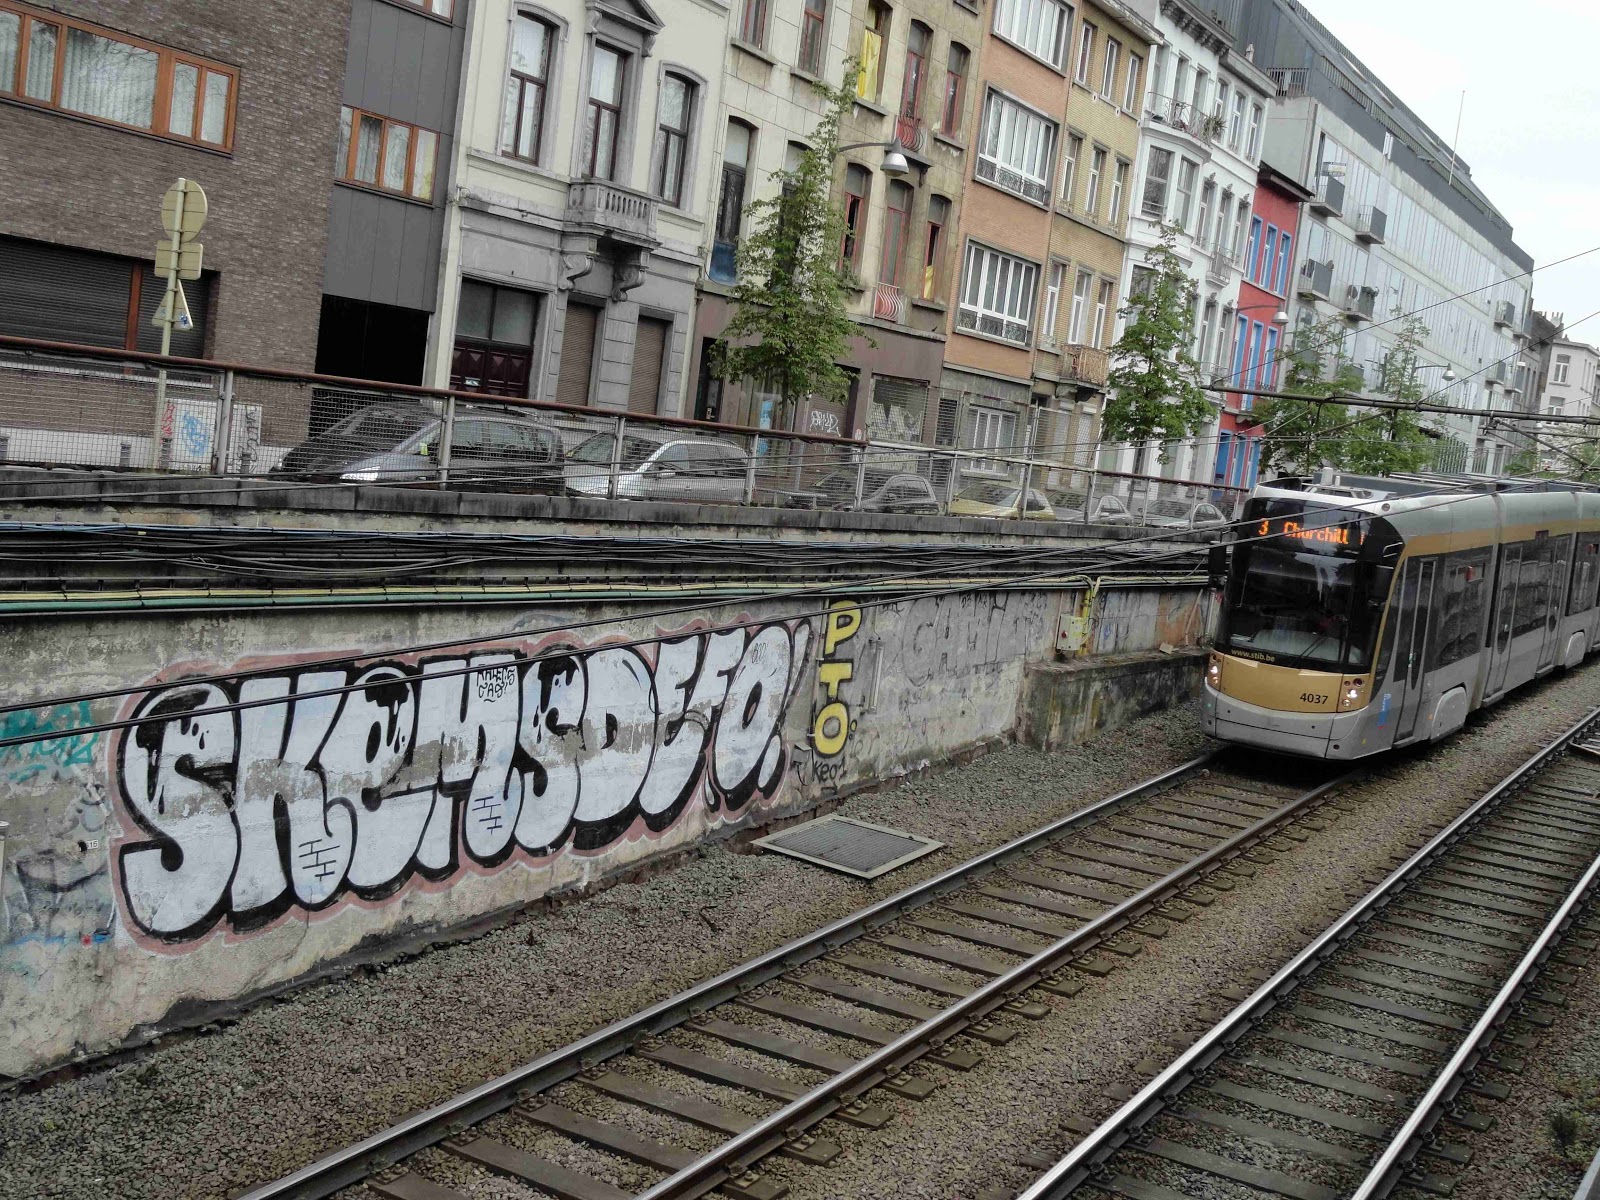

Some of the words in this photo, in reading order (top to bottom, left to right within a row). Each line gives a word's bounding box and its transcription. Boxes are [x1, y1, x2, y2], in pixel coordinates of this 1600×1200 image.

[1258, 519, 1269, 536] 3
[1283, 521, 1349, 544] Churchill
[1231, 649, 1275, 662] www.stib.be
[1300, 692, 1329, 705] 4037
